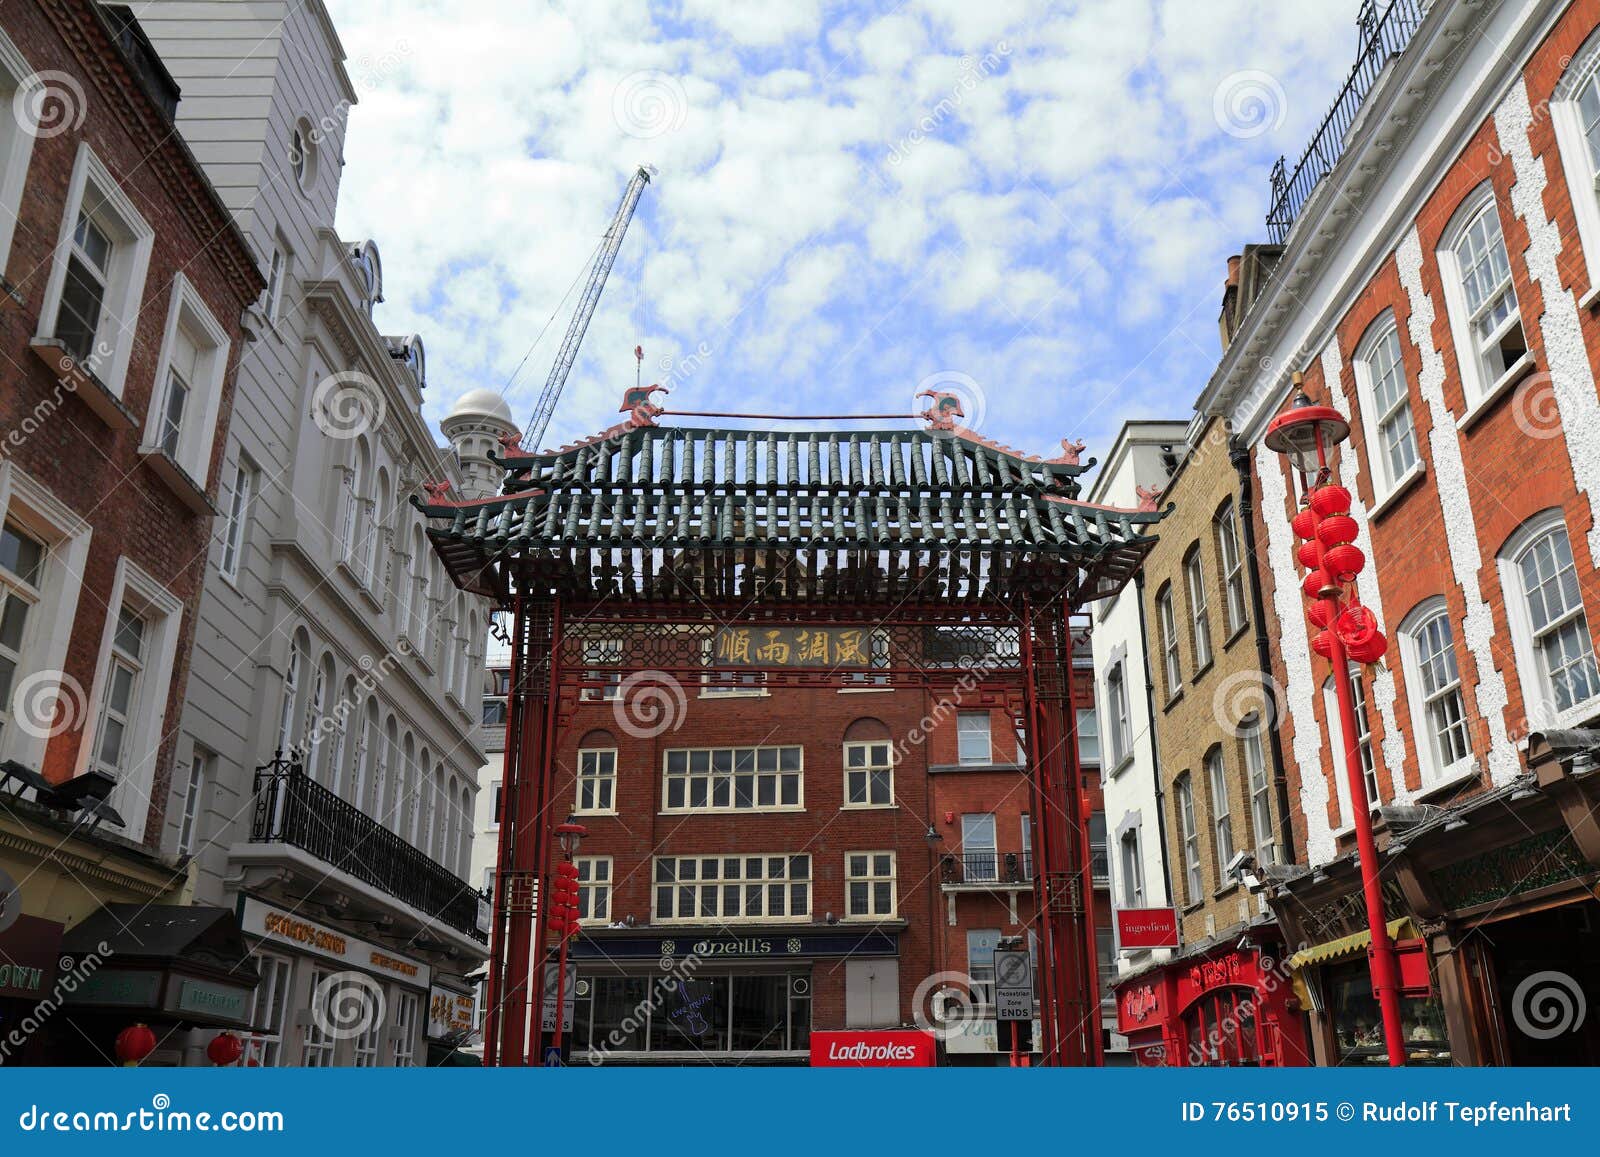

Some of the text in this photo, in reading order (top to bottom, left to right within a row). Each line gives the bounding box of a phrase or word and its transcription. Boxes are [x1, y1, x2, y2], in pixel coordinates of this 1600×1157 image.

[1125, 922, 1170, 935] ingredient
[1001, 1008, 1029, 1018] ENDS
[543, 1020, 569, 1030] ENS
[829, 1041, 916, 1060] Ladbrokes
